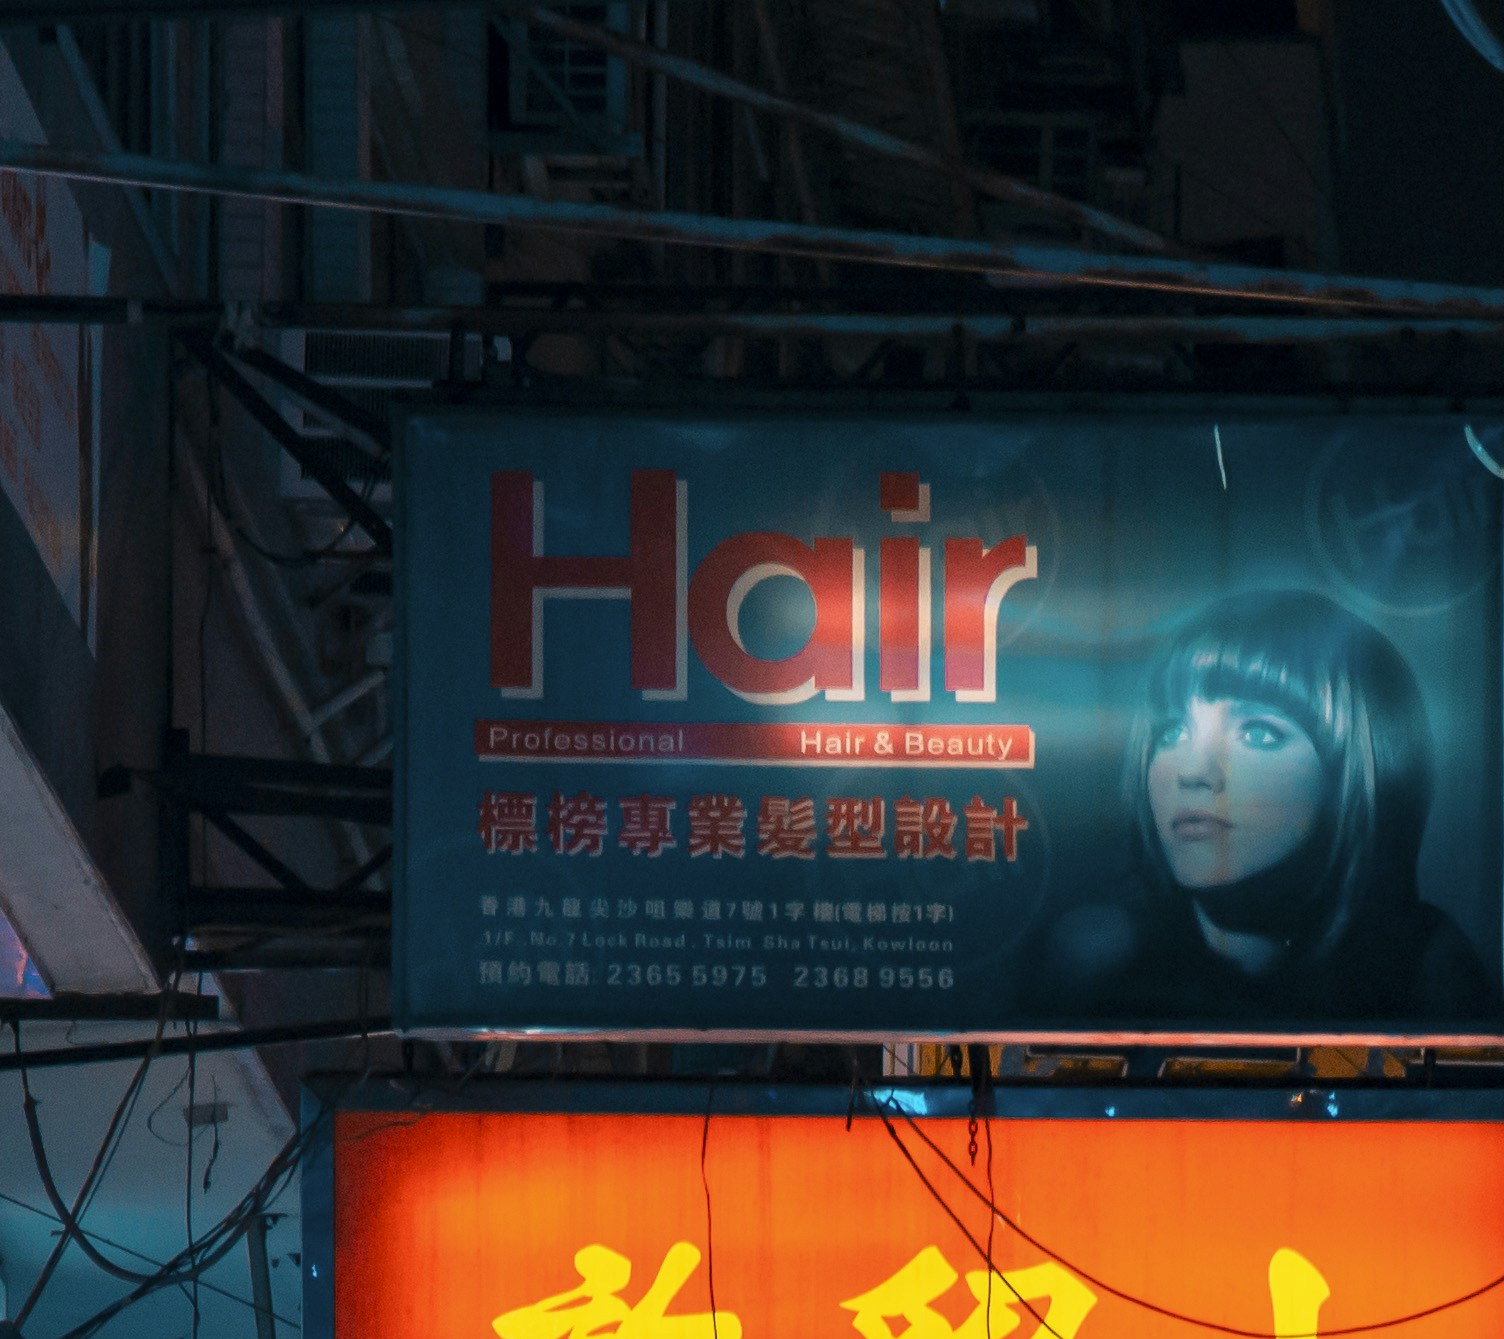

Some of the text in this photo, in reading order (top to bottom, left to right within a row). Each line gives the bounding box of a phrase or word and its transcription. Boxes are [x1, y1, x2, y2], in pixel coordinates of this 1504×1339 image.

[488, 470, 1037, 703] Hair
[488, 726, 1013, 761] Professional Hair & Beauty
[476, 791, 1029, 862] 標榜專業髮型設計
[704, 935, 753, 949] Tsim
[863, 937, 955, 953] Kowloon
[606, 963, 682, 987] 2365
[691, 964, 767, 988] 5975
[793, 965, 870, 990] 2368
[879, 966, 956, 990] 9556
